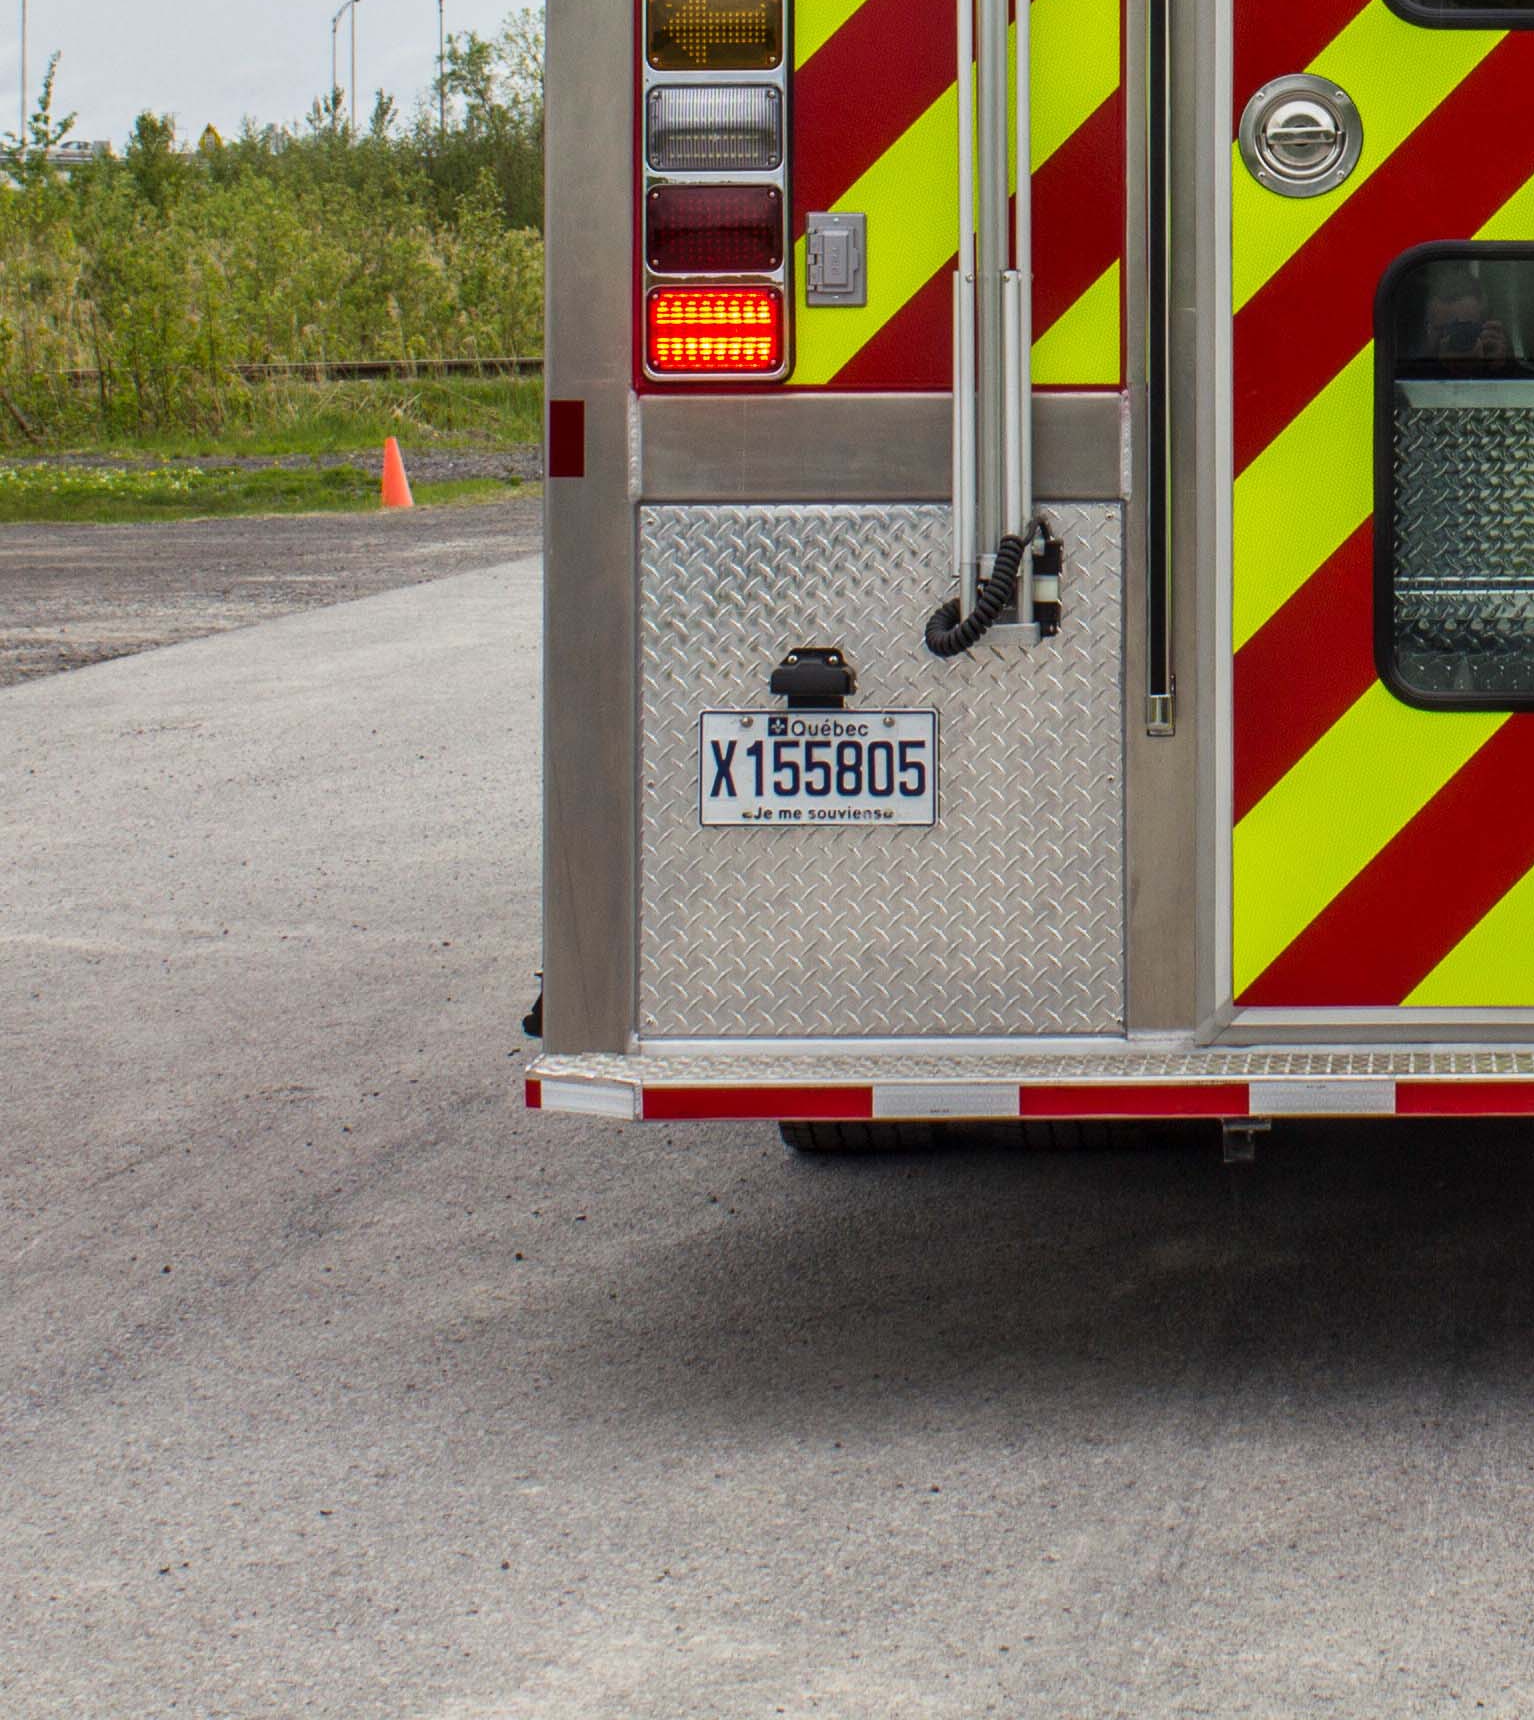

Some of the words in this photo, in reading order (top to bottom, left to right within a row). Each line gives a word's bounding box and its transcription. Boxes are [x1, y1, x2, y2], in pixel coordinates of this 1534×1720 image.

[791, 718, 869, 737] Québec
[710, 740, 926, 798] X155805
[753, 806, 773, 819] Je
[779, 808, 802, 819] me
